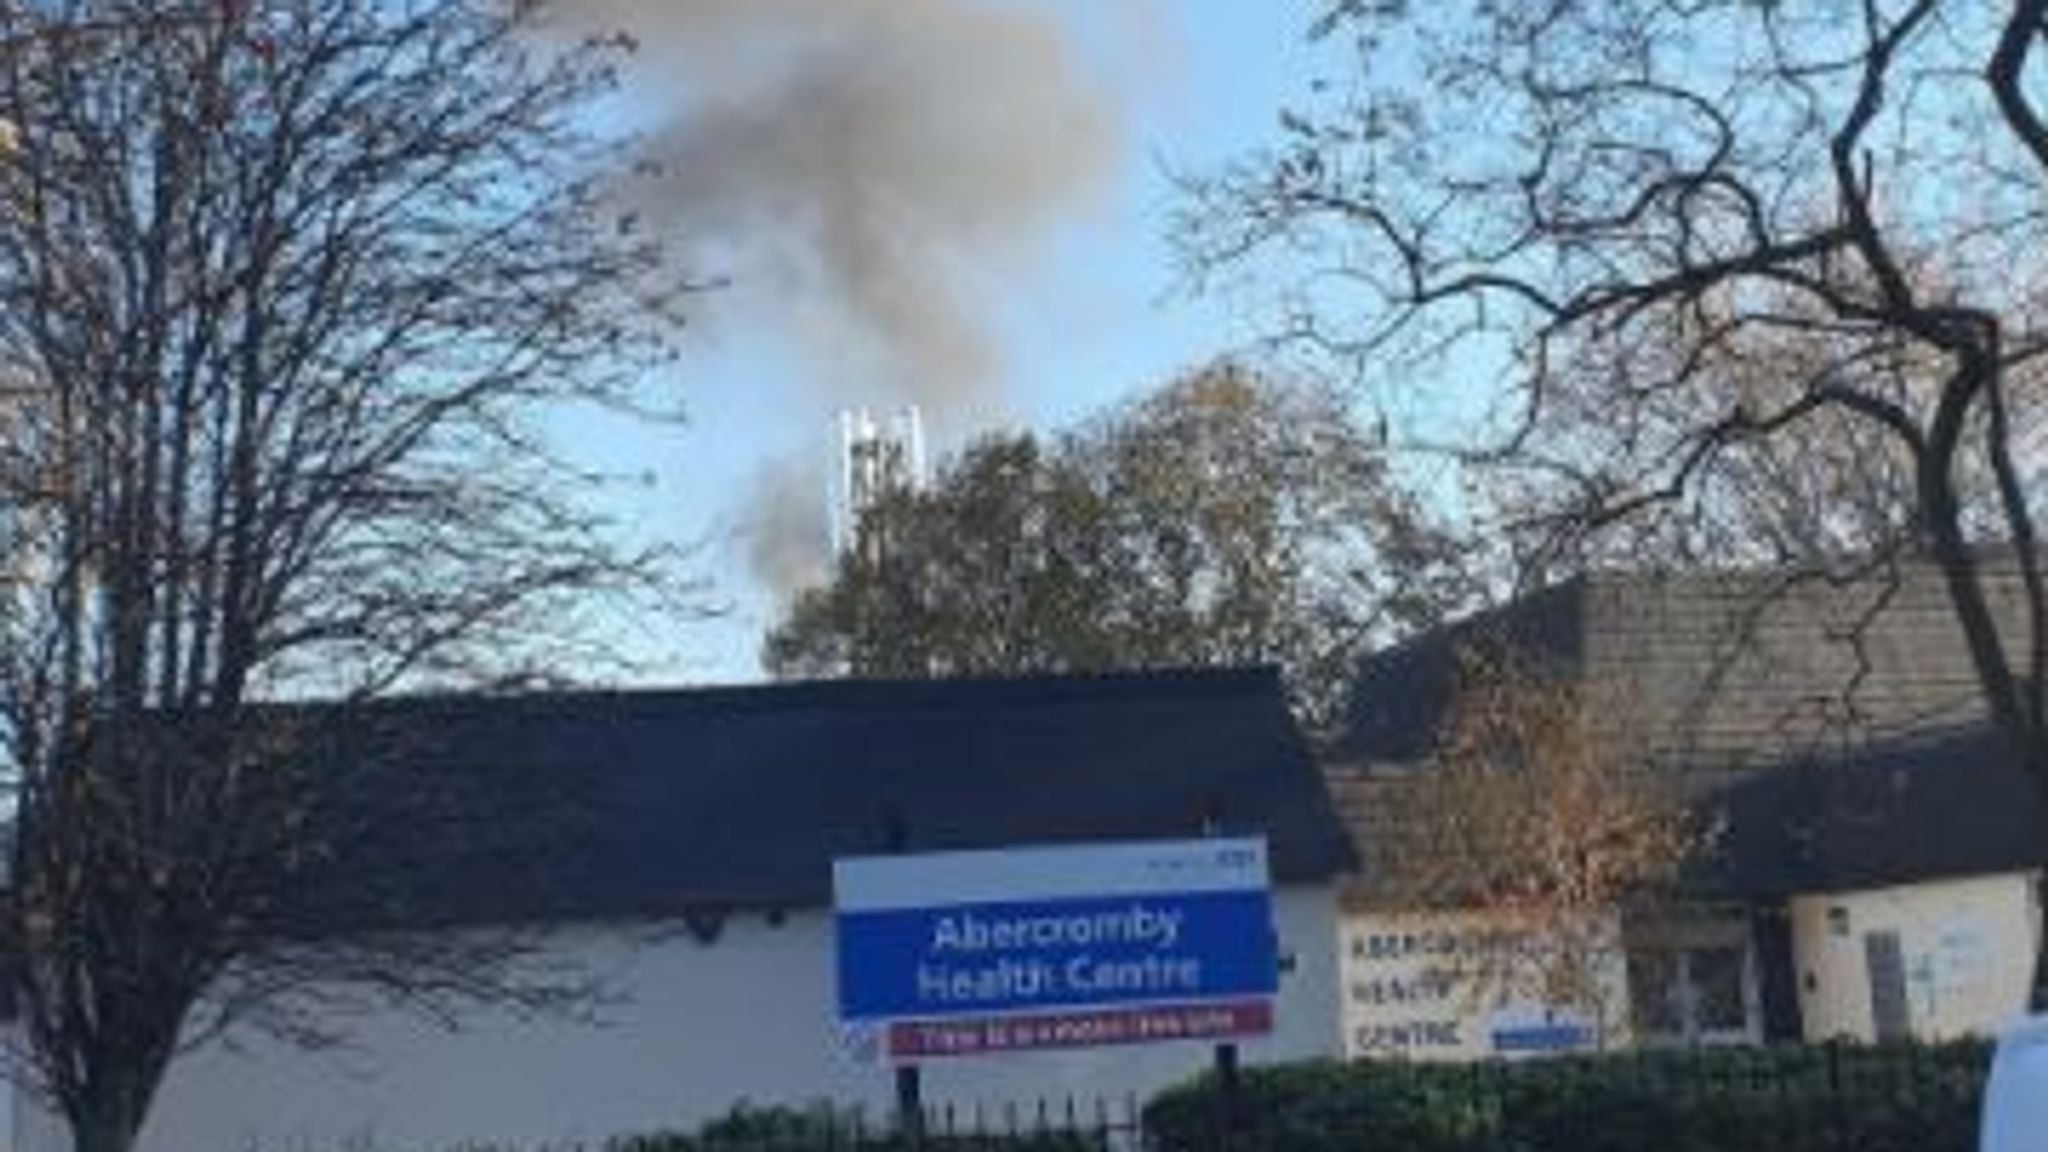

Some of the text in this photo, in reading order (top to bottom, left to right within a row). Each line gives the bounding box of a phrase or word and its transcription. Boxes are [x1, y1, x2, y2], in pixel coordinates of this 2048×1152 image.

[934, 903, 1183, 949] Abercromby
[918, 953, 1200, 1001] Health Centre
